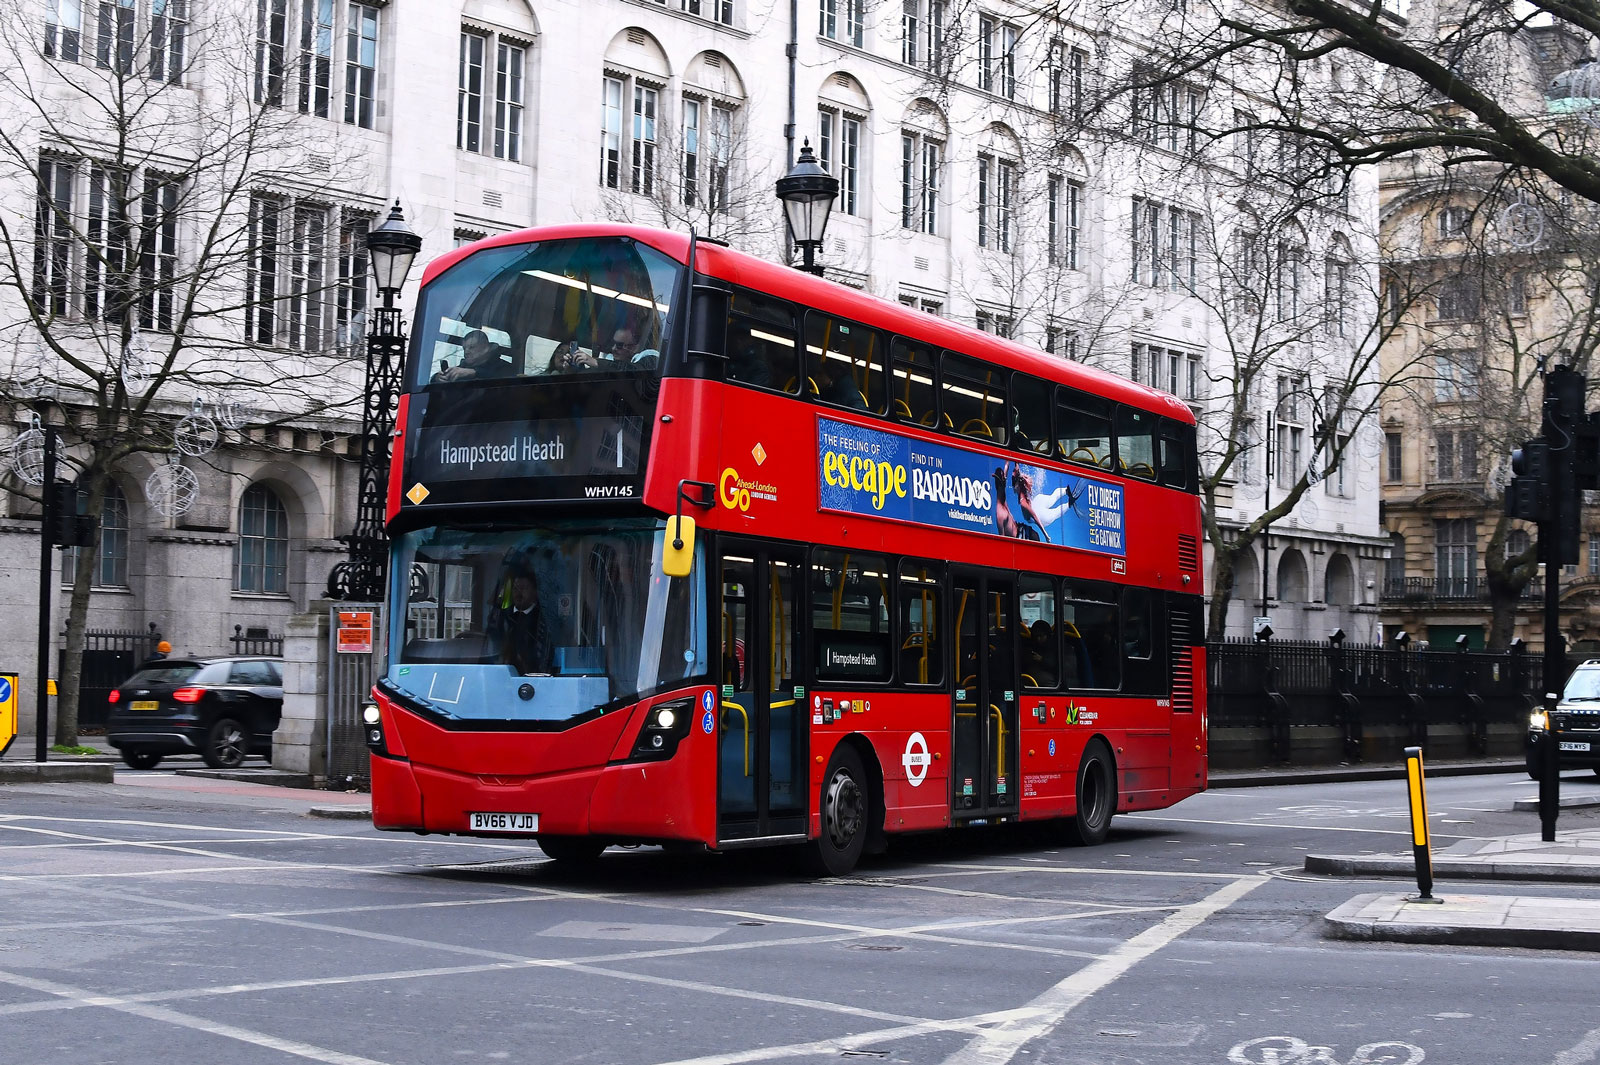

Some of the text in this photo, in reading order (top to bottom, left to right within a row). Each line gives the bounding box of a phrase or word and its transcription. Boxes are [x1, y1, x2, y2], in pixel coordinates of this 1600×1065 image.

[440, 435, 564, 471] Hampstead Heath
[824, 433, 881, 454] THE FEELING OF
[911, 452, 943, 469] FIND IT IN
[585, 485, 633, 497] WHV145
[720, 467, 750, 512] Go
[823, 451, 907, 511] escape
[912, 467, 992, 511] BARBADOS
[1088, 485, 1120, 511] FLY DIRECT
[1095, 509, 1121, 530] HEATHROW
[1100, 530, 1121, 549] GATWICK
[832, 651, 861, 667] Hampstead
[861, 652, 877, 666] Heath
[911, 755, 922, 763] BUSES
[475, 815, 533, 829] BV66 VJD
